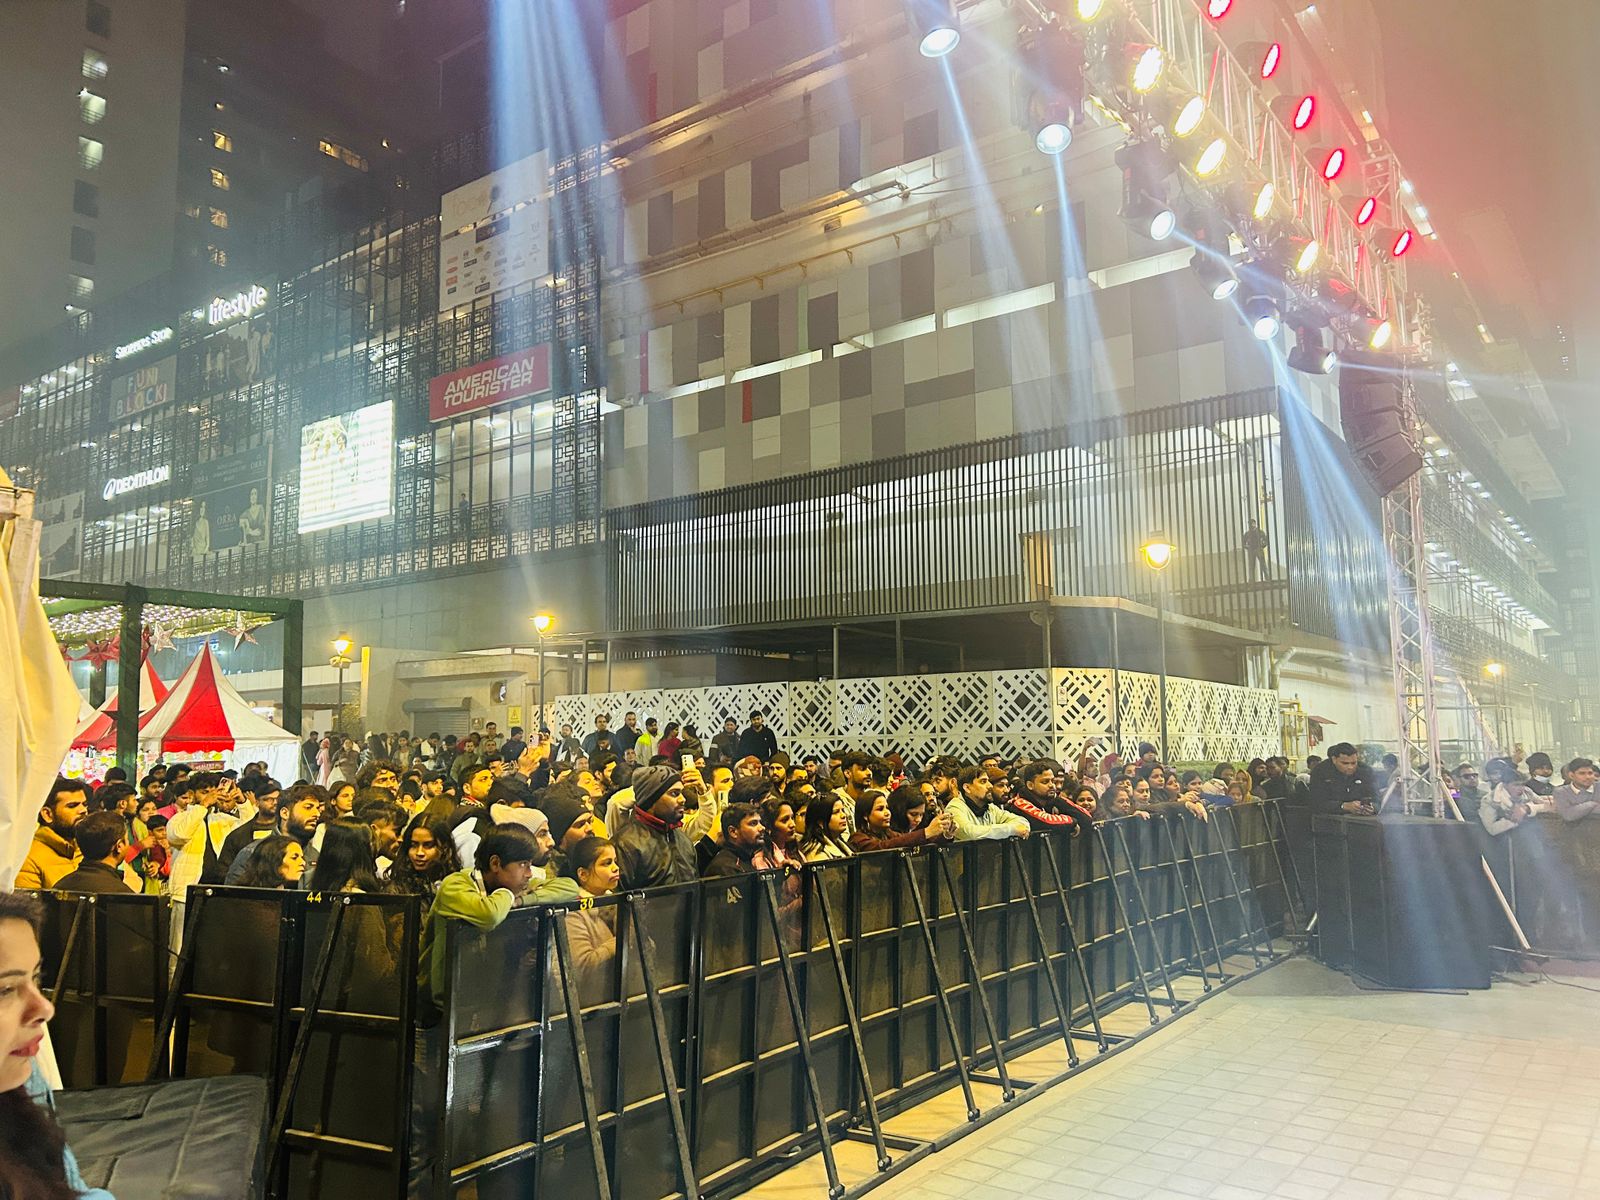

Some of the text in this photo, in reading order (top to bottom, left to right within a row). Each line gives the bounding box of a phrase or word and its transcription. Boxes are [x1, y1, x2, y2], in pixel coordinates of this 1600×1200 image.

[209, 284, 267, 325] lifestyle
[443, 371, 533, 408] TOURISTER
[445, 356, 534, 395] AMERICAN
[115, 464, 169, 494] DECATHLON
[307, 891, 322, 903] 44
[580, 897, 594, 910] 30
